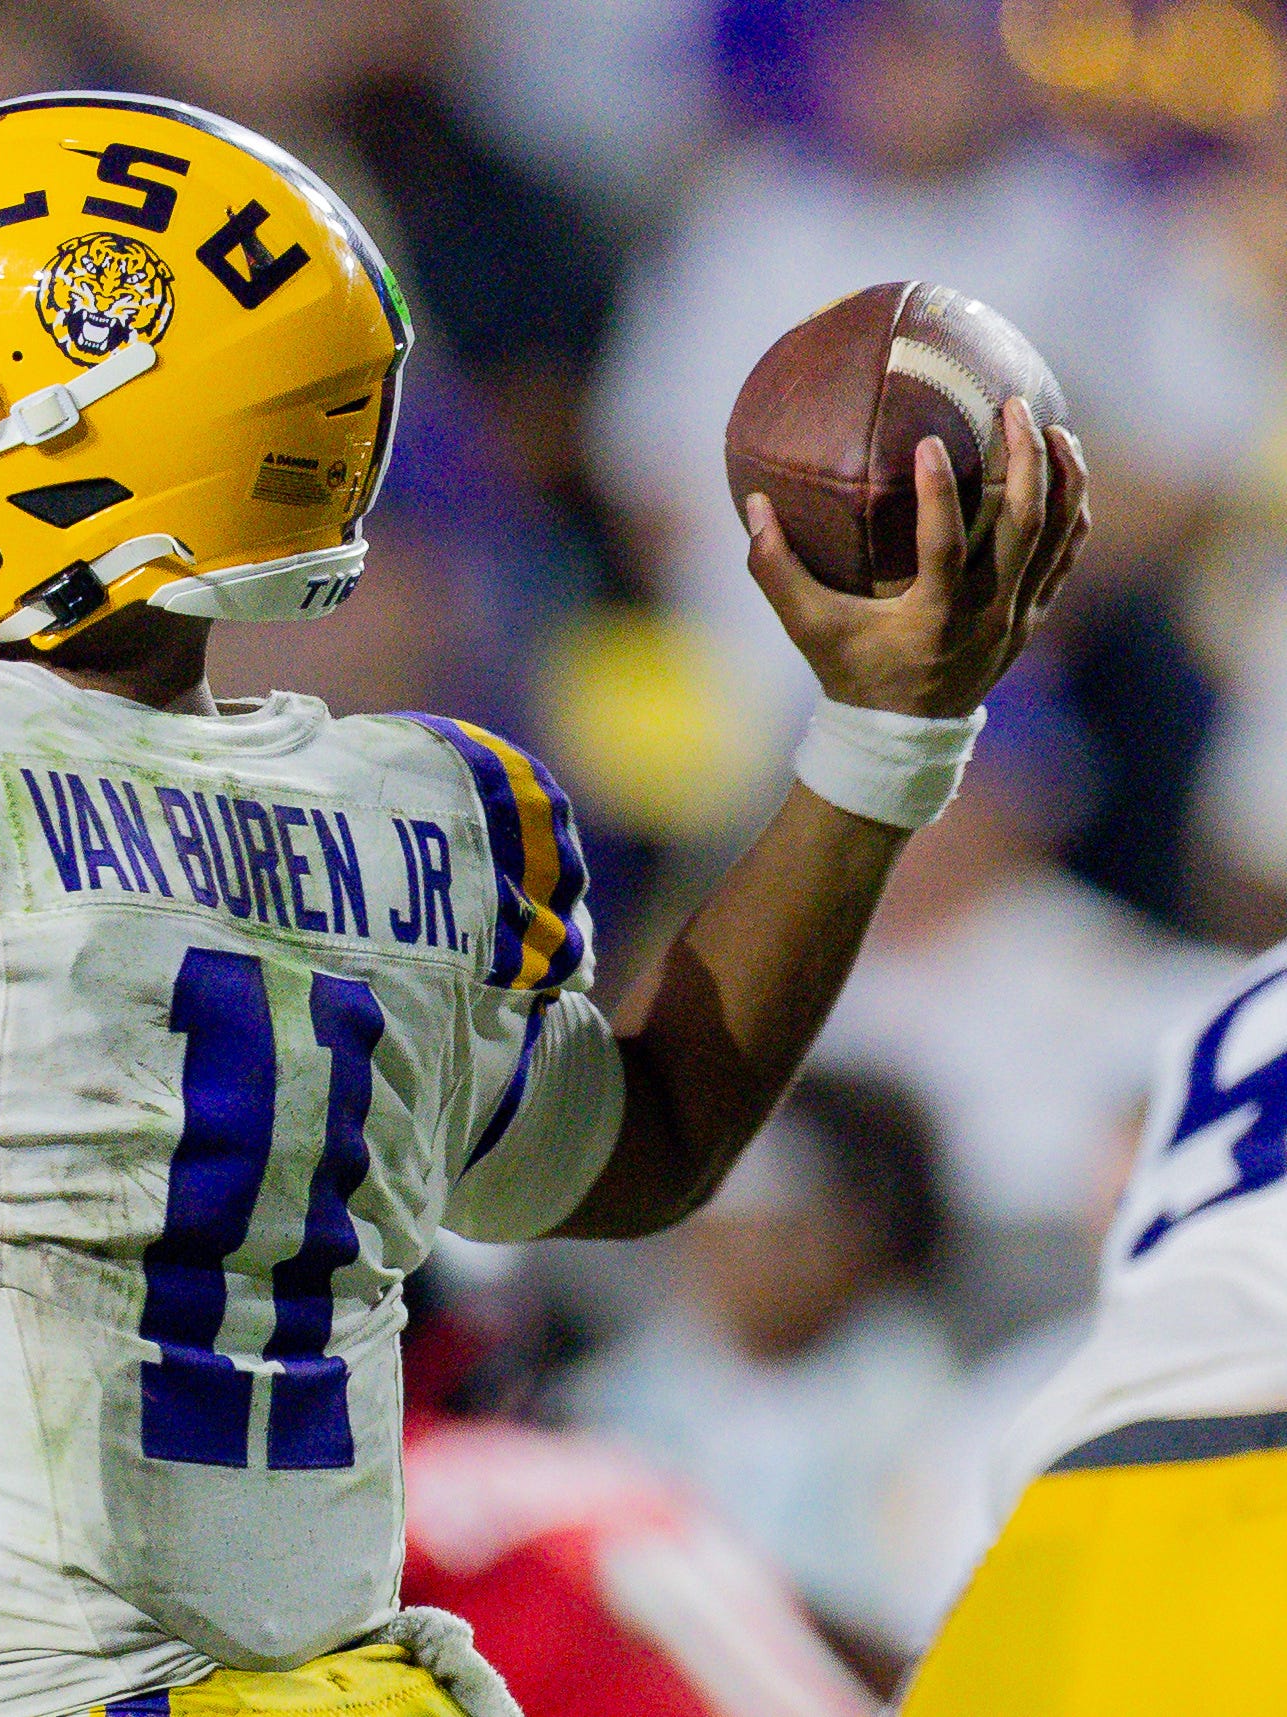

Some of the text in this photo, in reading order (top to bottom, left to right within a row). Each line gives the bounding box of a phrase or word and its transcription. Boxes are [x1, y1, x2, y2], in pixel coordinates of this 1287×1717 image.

[20, 767, 469, 955] VAN BUREN JR.
[139, 946, 386, 1471] 11
